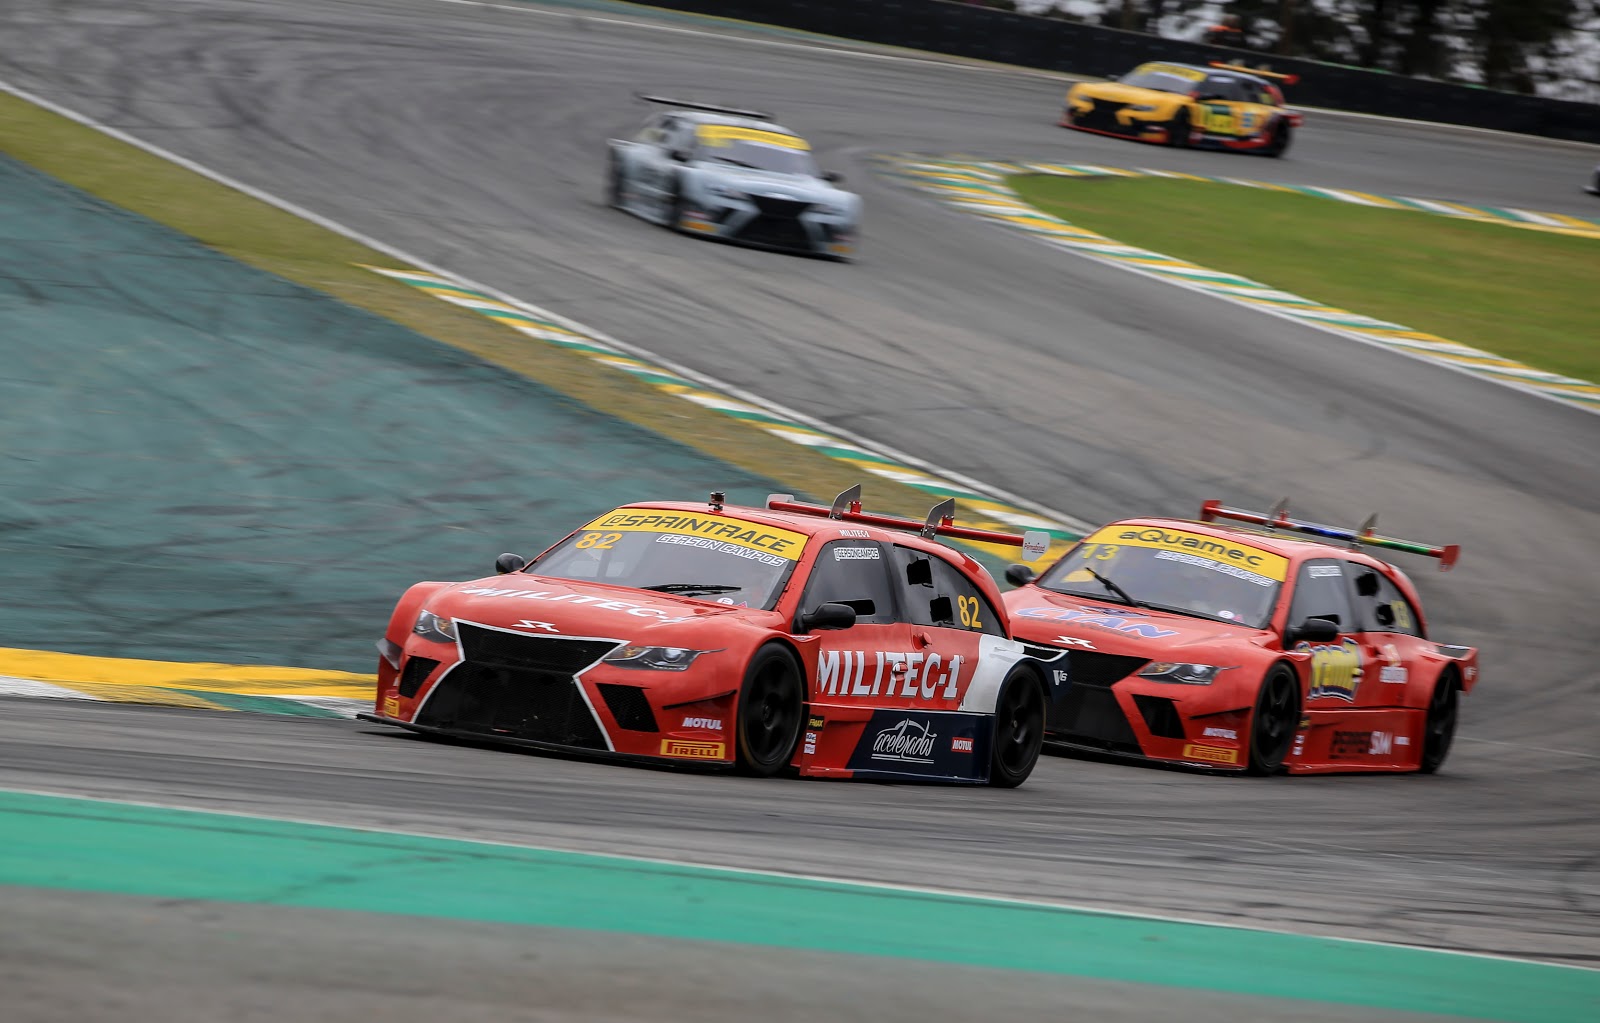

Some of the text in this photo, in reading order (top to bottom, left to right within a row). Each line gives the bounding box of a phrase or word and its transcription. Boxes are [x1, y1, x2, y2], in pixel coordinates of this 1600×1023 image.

[575, 532, 623, 550] 82
[600, 514, 795, 552] @SPRINTRACE
[839, 529, 870, 538] MILITEC-1
[656, 533, 789, 567] GERSON CAMPOS
[1081, 543, 1120, 561] 13
[957, 595, 983, 629] 82
[1015, 607, 1180, 639] CYAN
[816, 649, 962, 701] MILITEC-1
[682, 717, 723, 731] MOTUL
[666, 741, 721, 758] PIRELLI
[873, 718, 937, 758] acelerados
[952, 739, 973, 751] MOTUL
